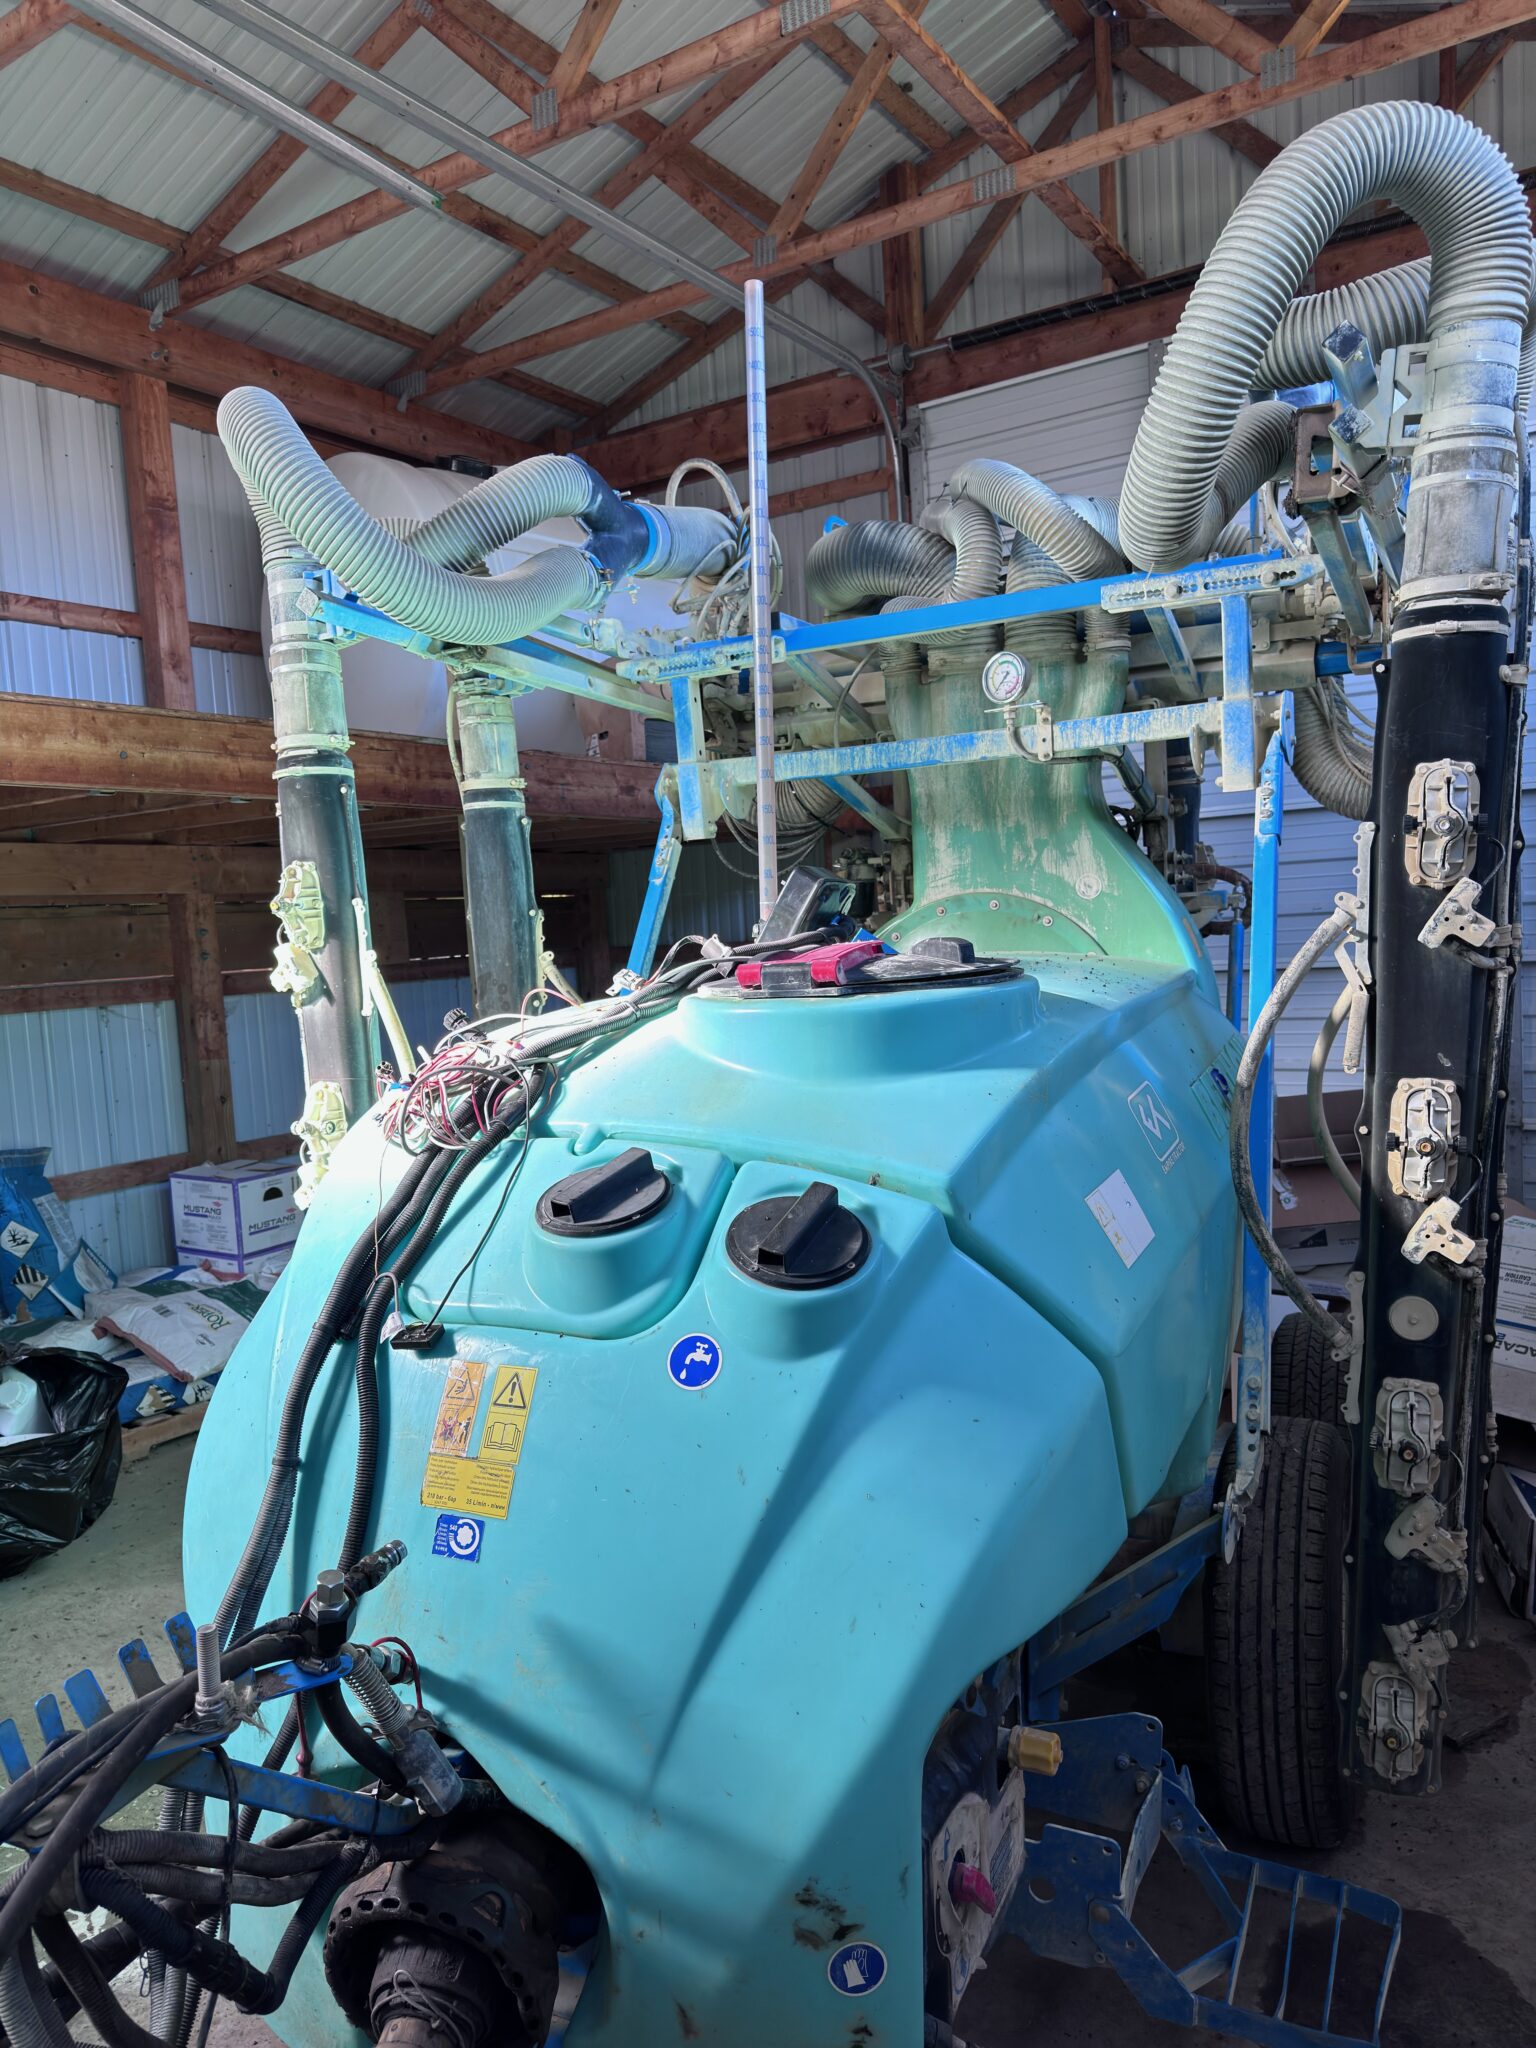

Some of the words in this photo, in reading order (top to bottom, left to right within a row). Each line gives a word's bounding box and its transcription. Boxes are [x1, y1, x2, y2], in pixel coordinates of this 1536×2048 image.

[183, 1203, 222, 1216] MUSTANG
[248, 1213, 296, 1231] MUSTANG
[1504, 1271, 1532, 1282] CAUTION
